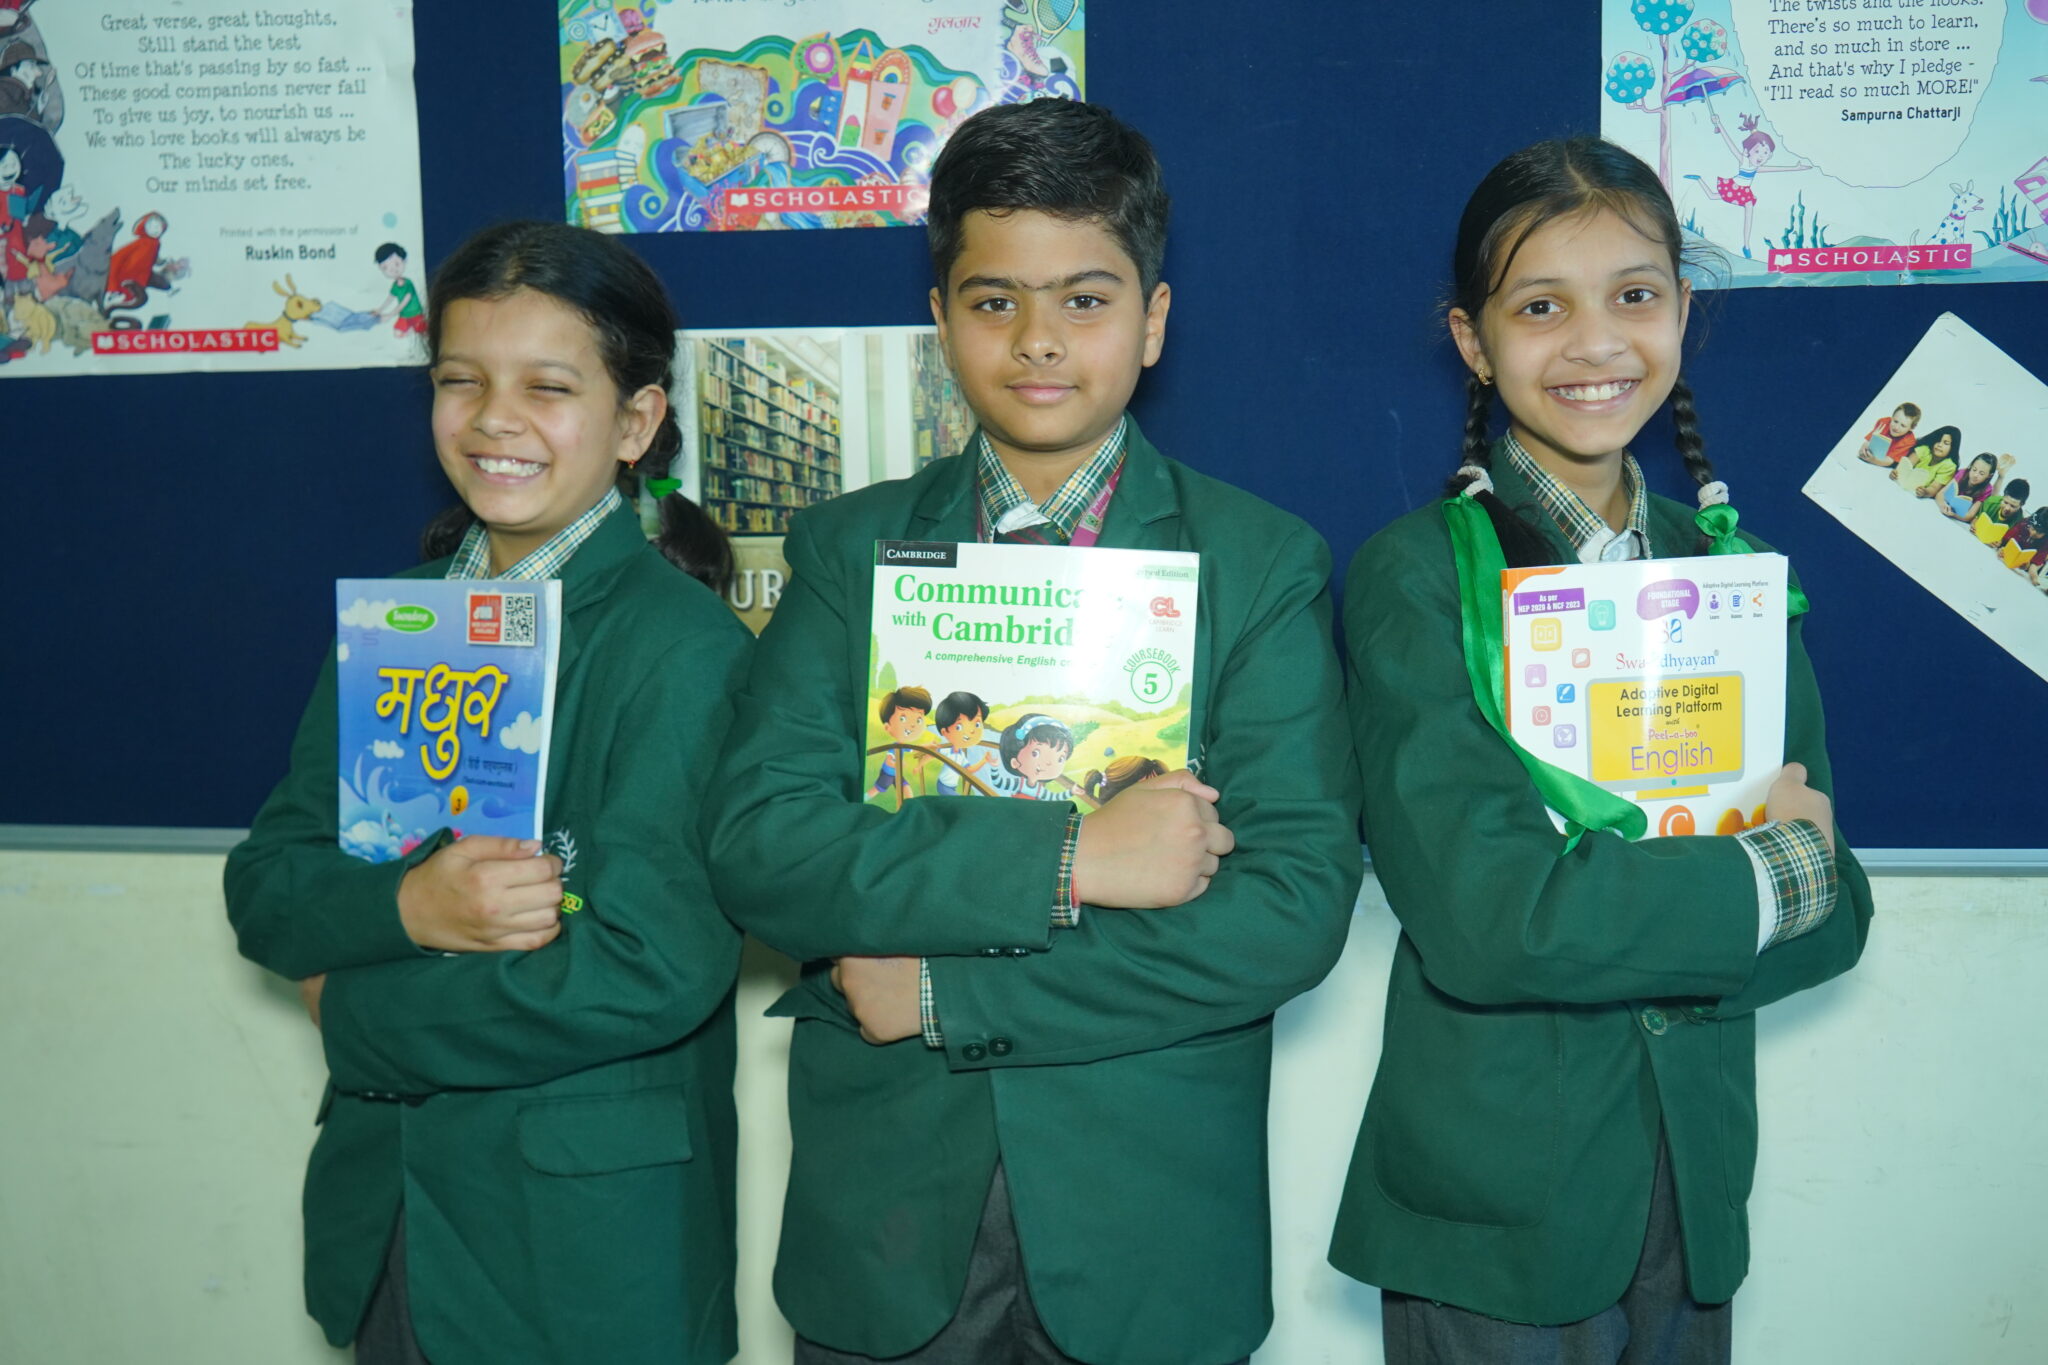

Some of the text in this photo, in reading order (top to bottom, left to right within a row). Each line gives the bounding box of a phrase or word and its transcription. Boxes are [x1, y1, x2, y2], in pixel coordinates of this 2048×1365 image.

[1807, 0, 1857, 11] twists
[101, 14, 147, 32] Great
[208, 11, 249, 30] great
[1768, 14, 1978, 35] There's so much to learn,
[138, 34, 301, 53] Still stand the test
[1774, 41, 1804, 56] and
[1810, 42, 1828, 55] so
[1835, 38, 1881, 54] much
[1887, 38, 1903, 52] in
[1910, 37, 1950, 51] store
[75, 62, 96, 79] Of
[101, 61, 140, 78] time
[146, 59, 193, 76] that's
[199, 58, 261, 77] passing
[267, 58, 288, 76] by
[293, 60, 311, 73] so
[318, 56, 349, 73] fast
[1769, 63, 1803, 80] And
[1809, 61, 1855, 78] that's
[1860, 60, 1894, 77] why
[1899, 59, 1906, 74] I
[1911, 58, 1962, 76] pledge
[79, 79, 367, 102] These good companions never fail
[1764, 79, 1979, 101] "I'll read so much MORE!"
[93, 108, 114, 125] To
[119, 107, 152, 127] give
[158, 110, 177, 123] us
[219, 105, 237, 122] to
[244, 103, 308, 121] nourish
[314, 106, 333, 119] us
[1841, 106, 1961, 124] Sampurna Chattarji
[84, 125, 366, 148] We who love books will always be
[159, 153, 191, 170] The
[197, 152, 245, 171] lucky
[146, 176, 178, 193] Our
[185, 175, 237, 192] minds
[244, 174, 268, 190] set
[754, 190, 920, 207] SCHOLASTIC
[245, 243, 336, 260] Ruskin Bond
[1798, 248, 1967, 267] SCHOLASTIC
[117, 331, 276, 350] SCHOLASTIC
[1161, 569, 1189, 578] Edition
[1539, 594, 1558, 602] As per
[1647, 589, 1691, 600] FOUNDATIONAL
[1661, 599, 1680, 609] STAGE
[1518, 605, 1530, 613] NEP
[1553, 602, 1565, 610] NCF
[892, 611, 926, 627] with
[924, 651, 933, 660] A
[935, 651, 1013, 665] comprehensive
[1017, 655, 1056, 668] English
[1123, 648, 1181, 674] COURSEBOOK
[1143, 673, 1158, 695] 5
[1620, 683, 1719, 702] Adaptive Digital
[1616, 700, 1722, 718] Learning Platform
[375, 663, 509, 780] मधुर
[1665, 718, 1680, 726] with
[1631, 741, 1713, 775] English
